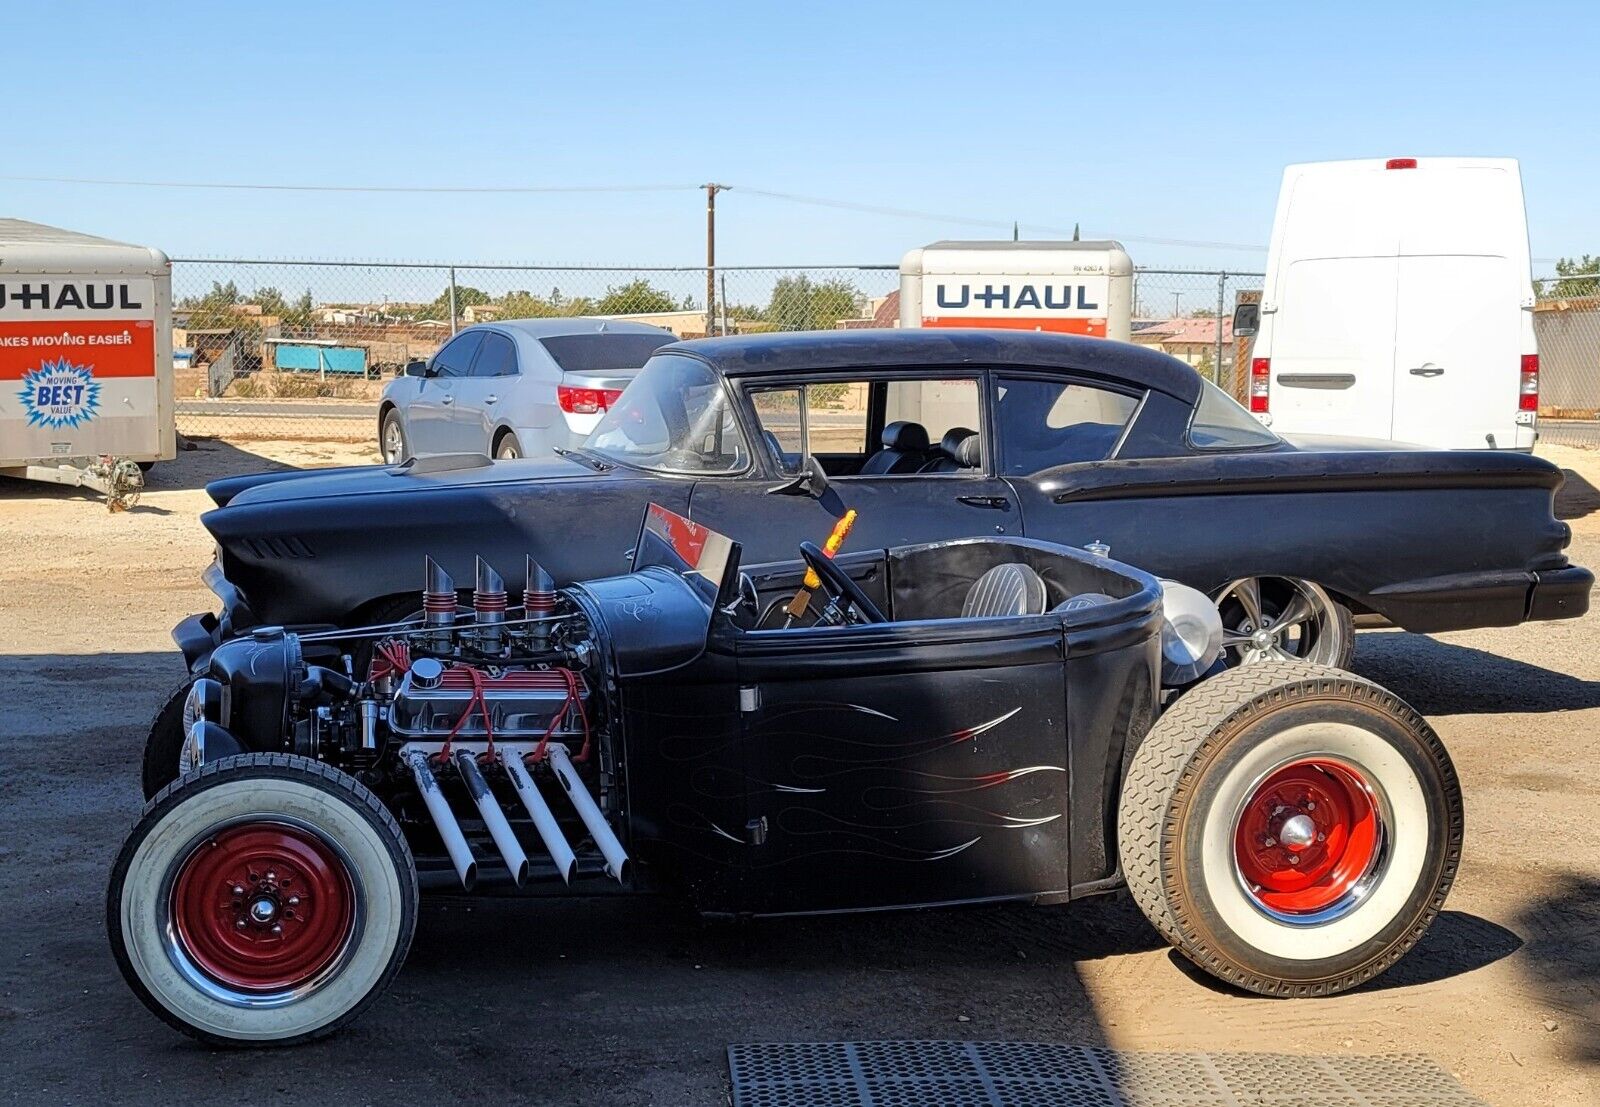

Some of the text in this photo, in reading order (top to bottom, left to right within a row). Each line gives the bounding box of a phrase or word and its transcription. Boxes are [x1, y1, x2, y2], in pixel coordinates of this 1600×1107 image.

[0, 283, 142, 310] -HAUL
[936, 284, 1099, 310] U-HAUL
[32, 335, 86, 346] MOVING
[88, 334, 132, 345] EASIER
[46, 376, 78, 385] MOVING
[37, 385, 85, 406] BEST
[50, 406, 73, 415] VALUE
